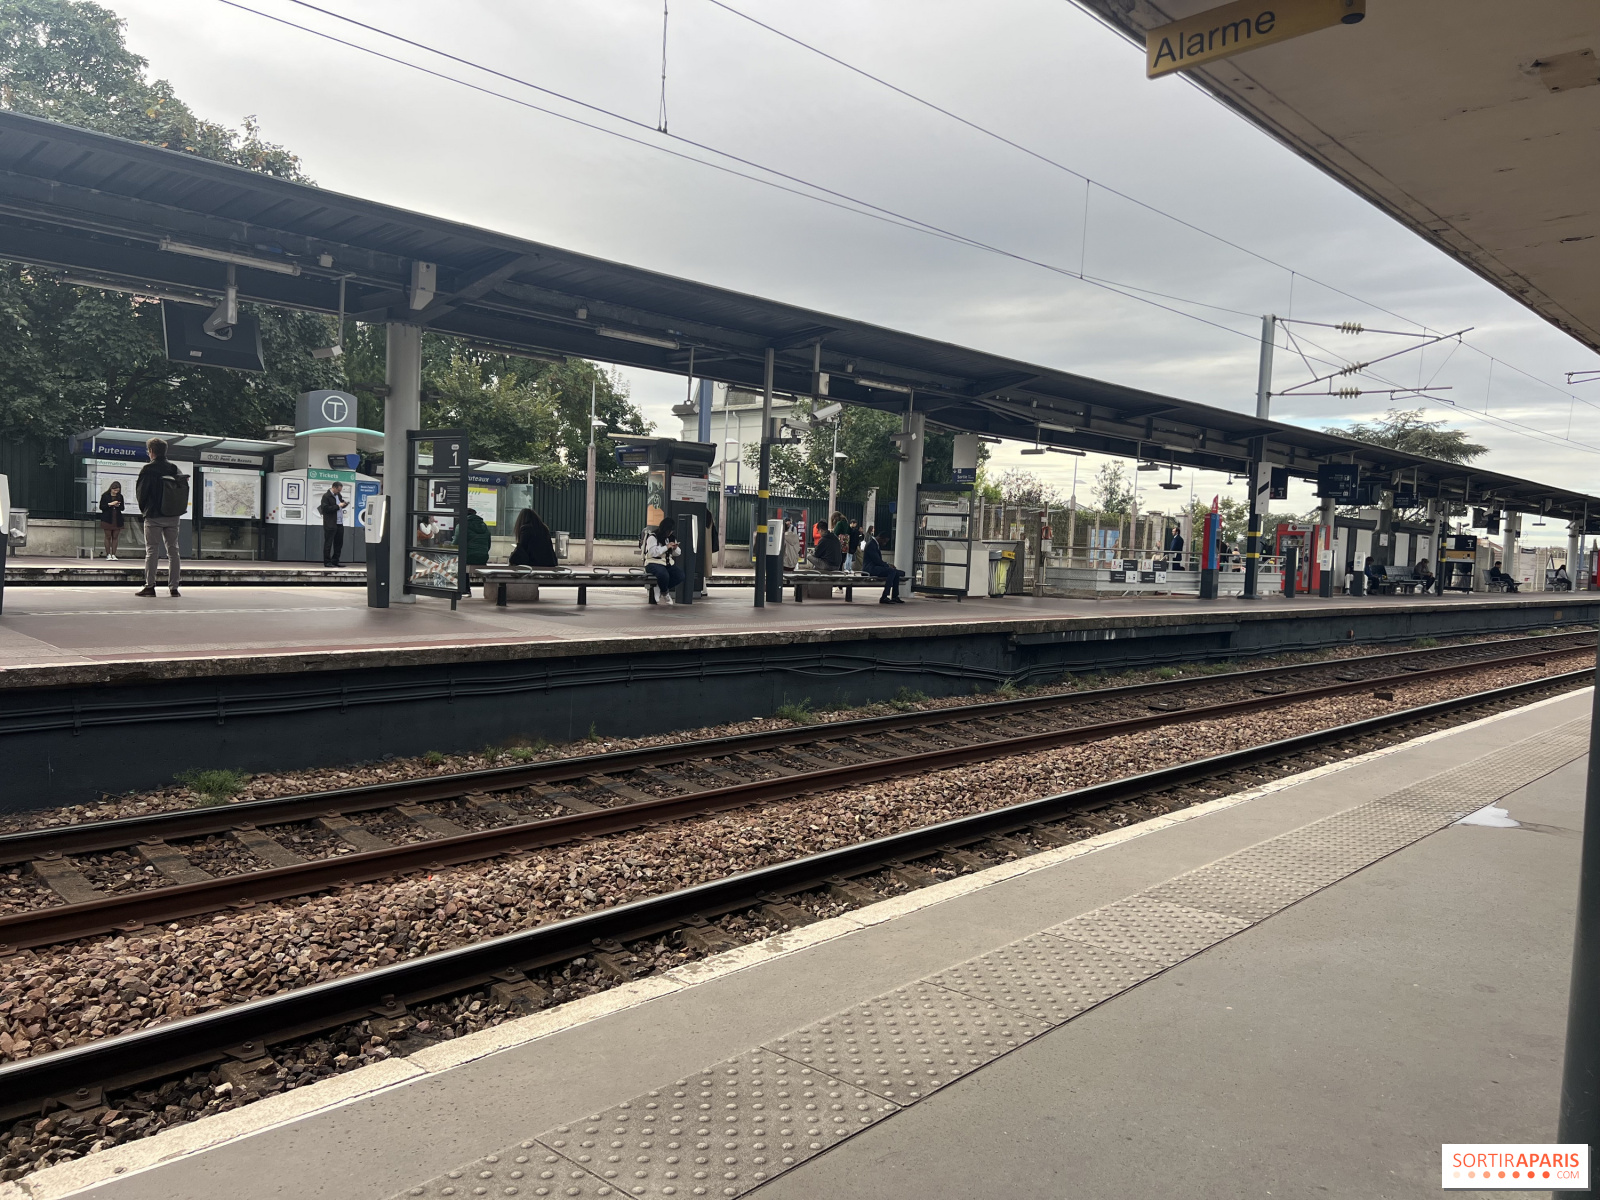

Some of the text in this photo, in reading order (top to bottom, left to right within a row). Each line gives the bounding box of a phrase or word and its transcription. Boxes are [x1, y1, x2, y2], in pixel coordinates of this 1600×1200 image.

[1153, 11, 1276, 68] Alarme
[98, 445, 136, 456] Puteaux
[452, 451, 458, 466] 1
